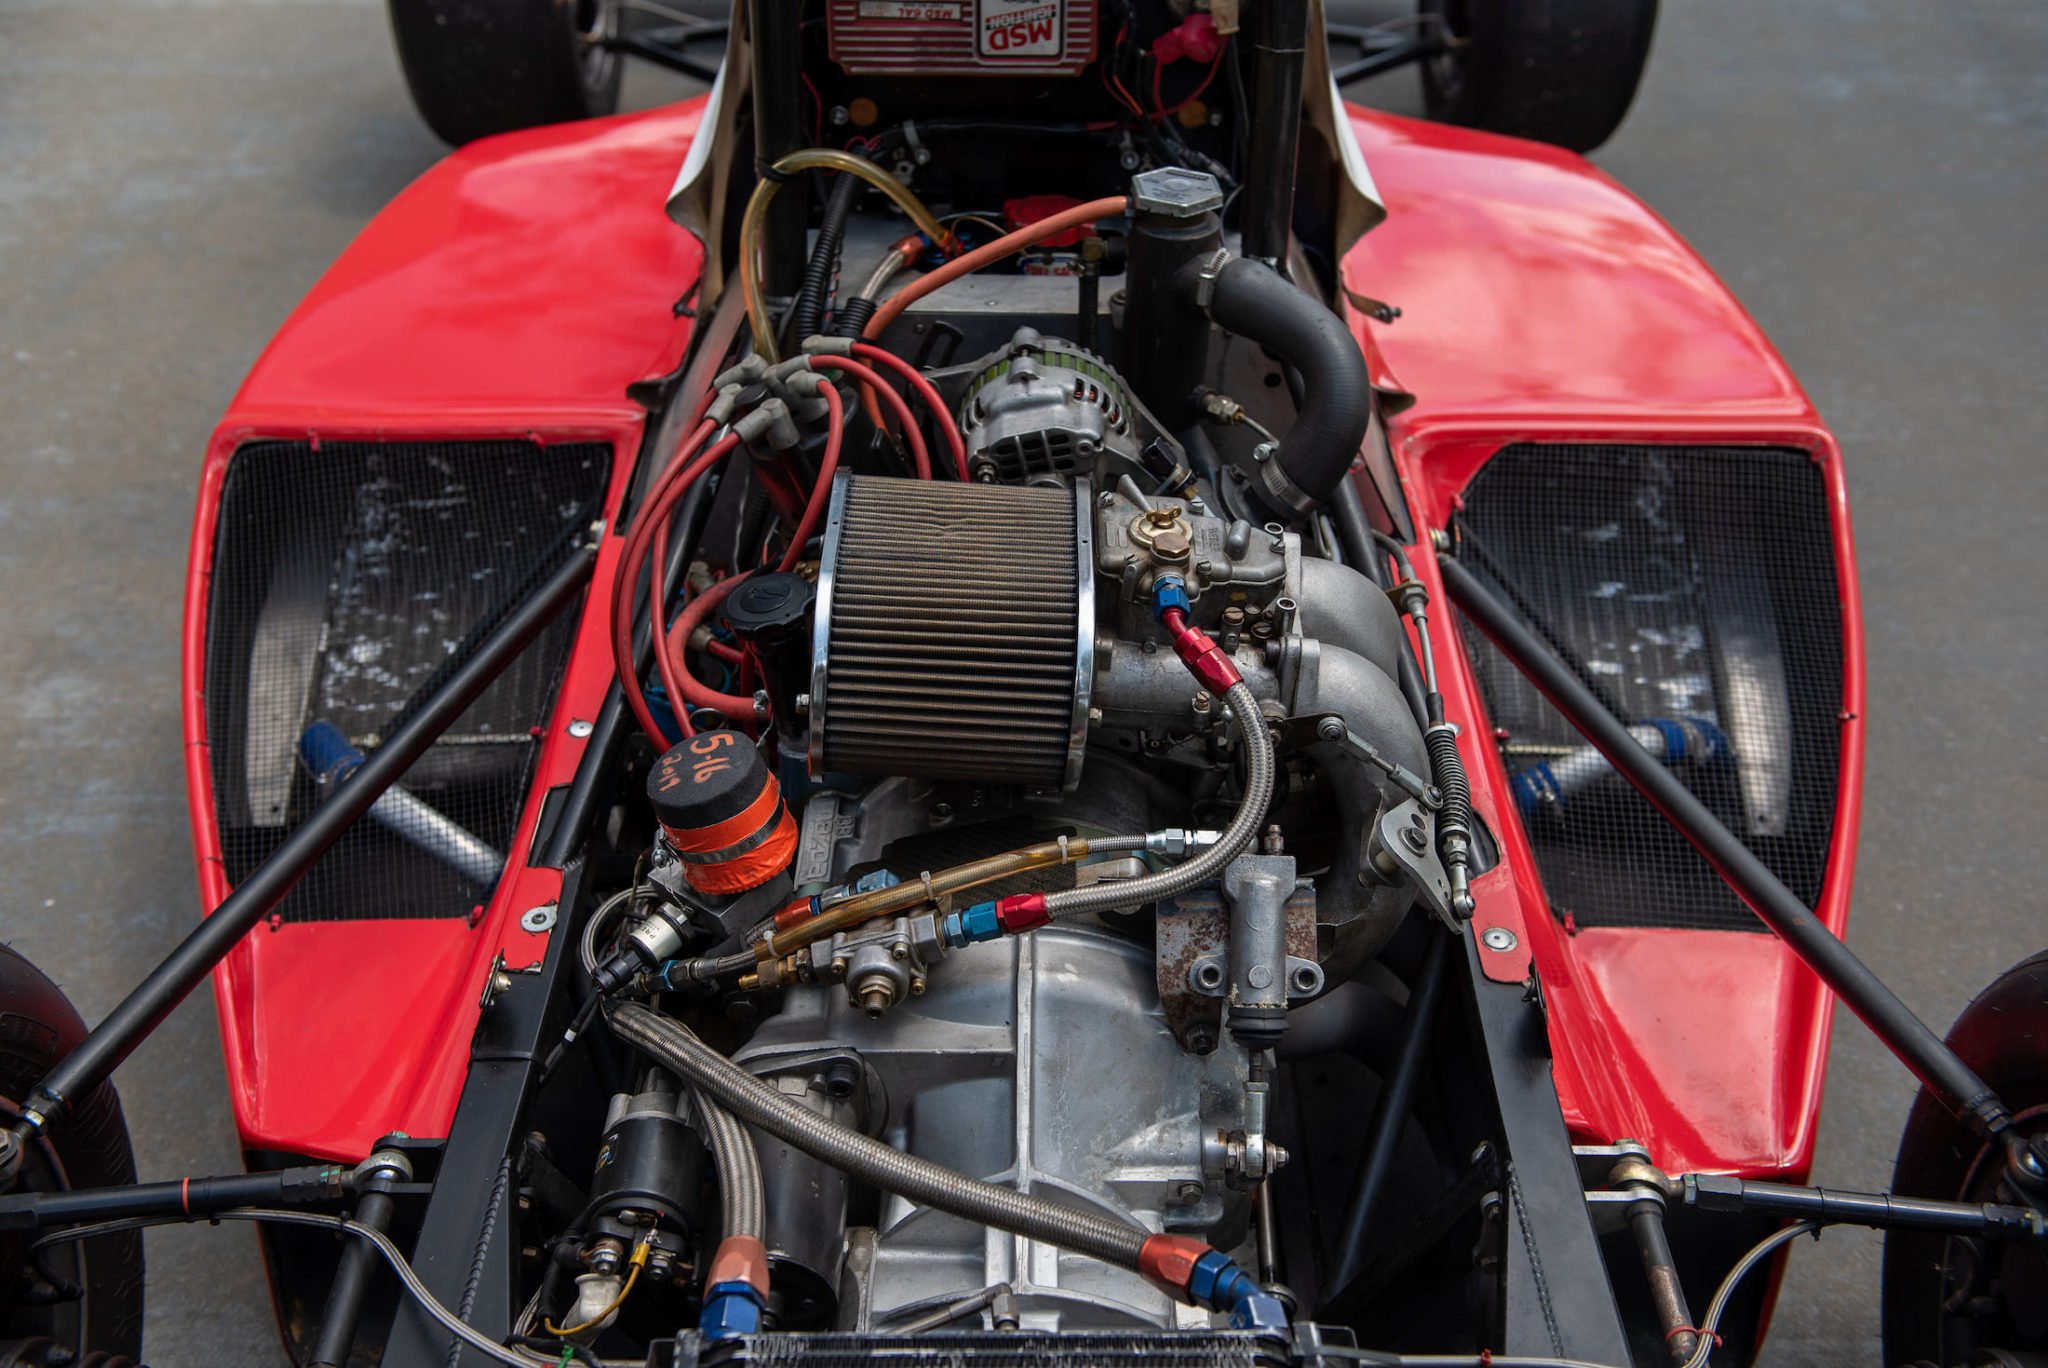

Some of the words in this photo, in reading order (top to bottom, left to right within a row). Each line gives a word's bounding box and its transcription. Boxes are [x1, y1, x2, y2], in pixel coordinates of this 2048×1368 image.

[925, 8, 953, 18] MSD
[986, 5, 1055, 29] IGNITION
[989, 18, 1053, 50] MSD
[659, 753, 682, 792] 2019
